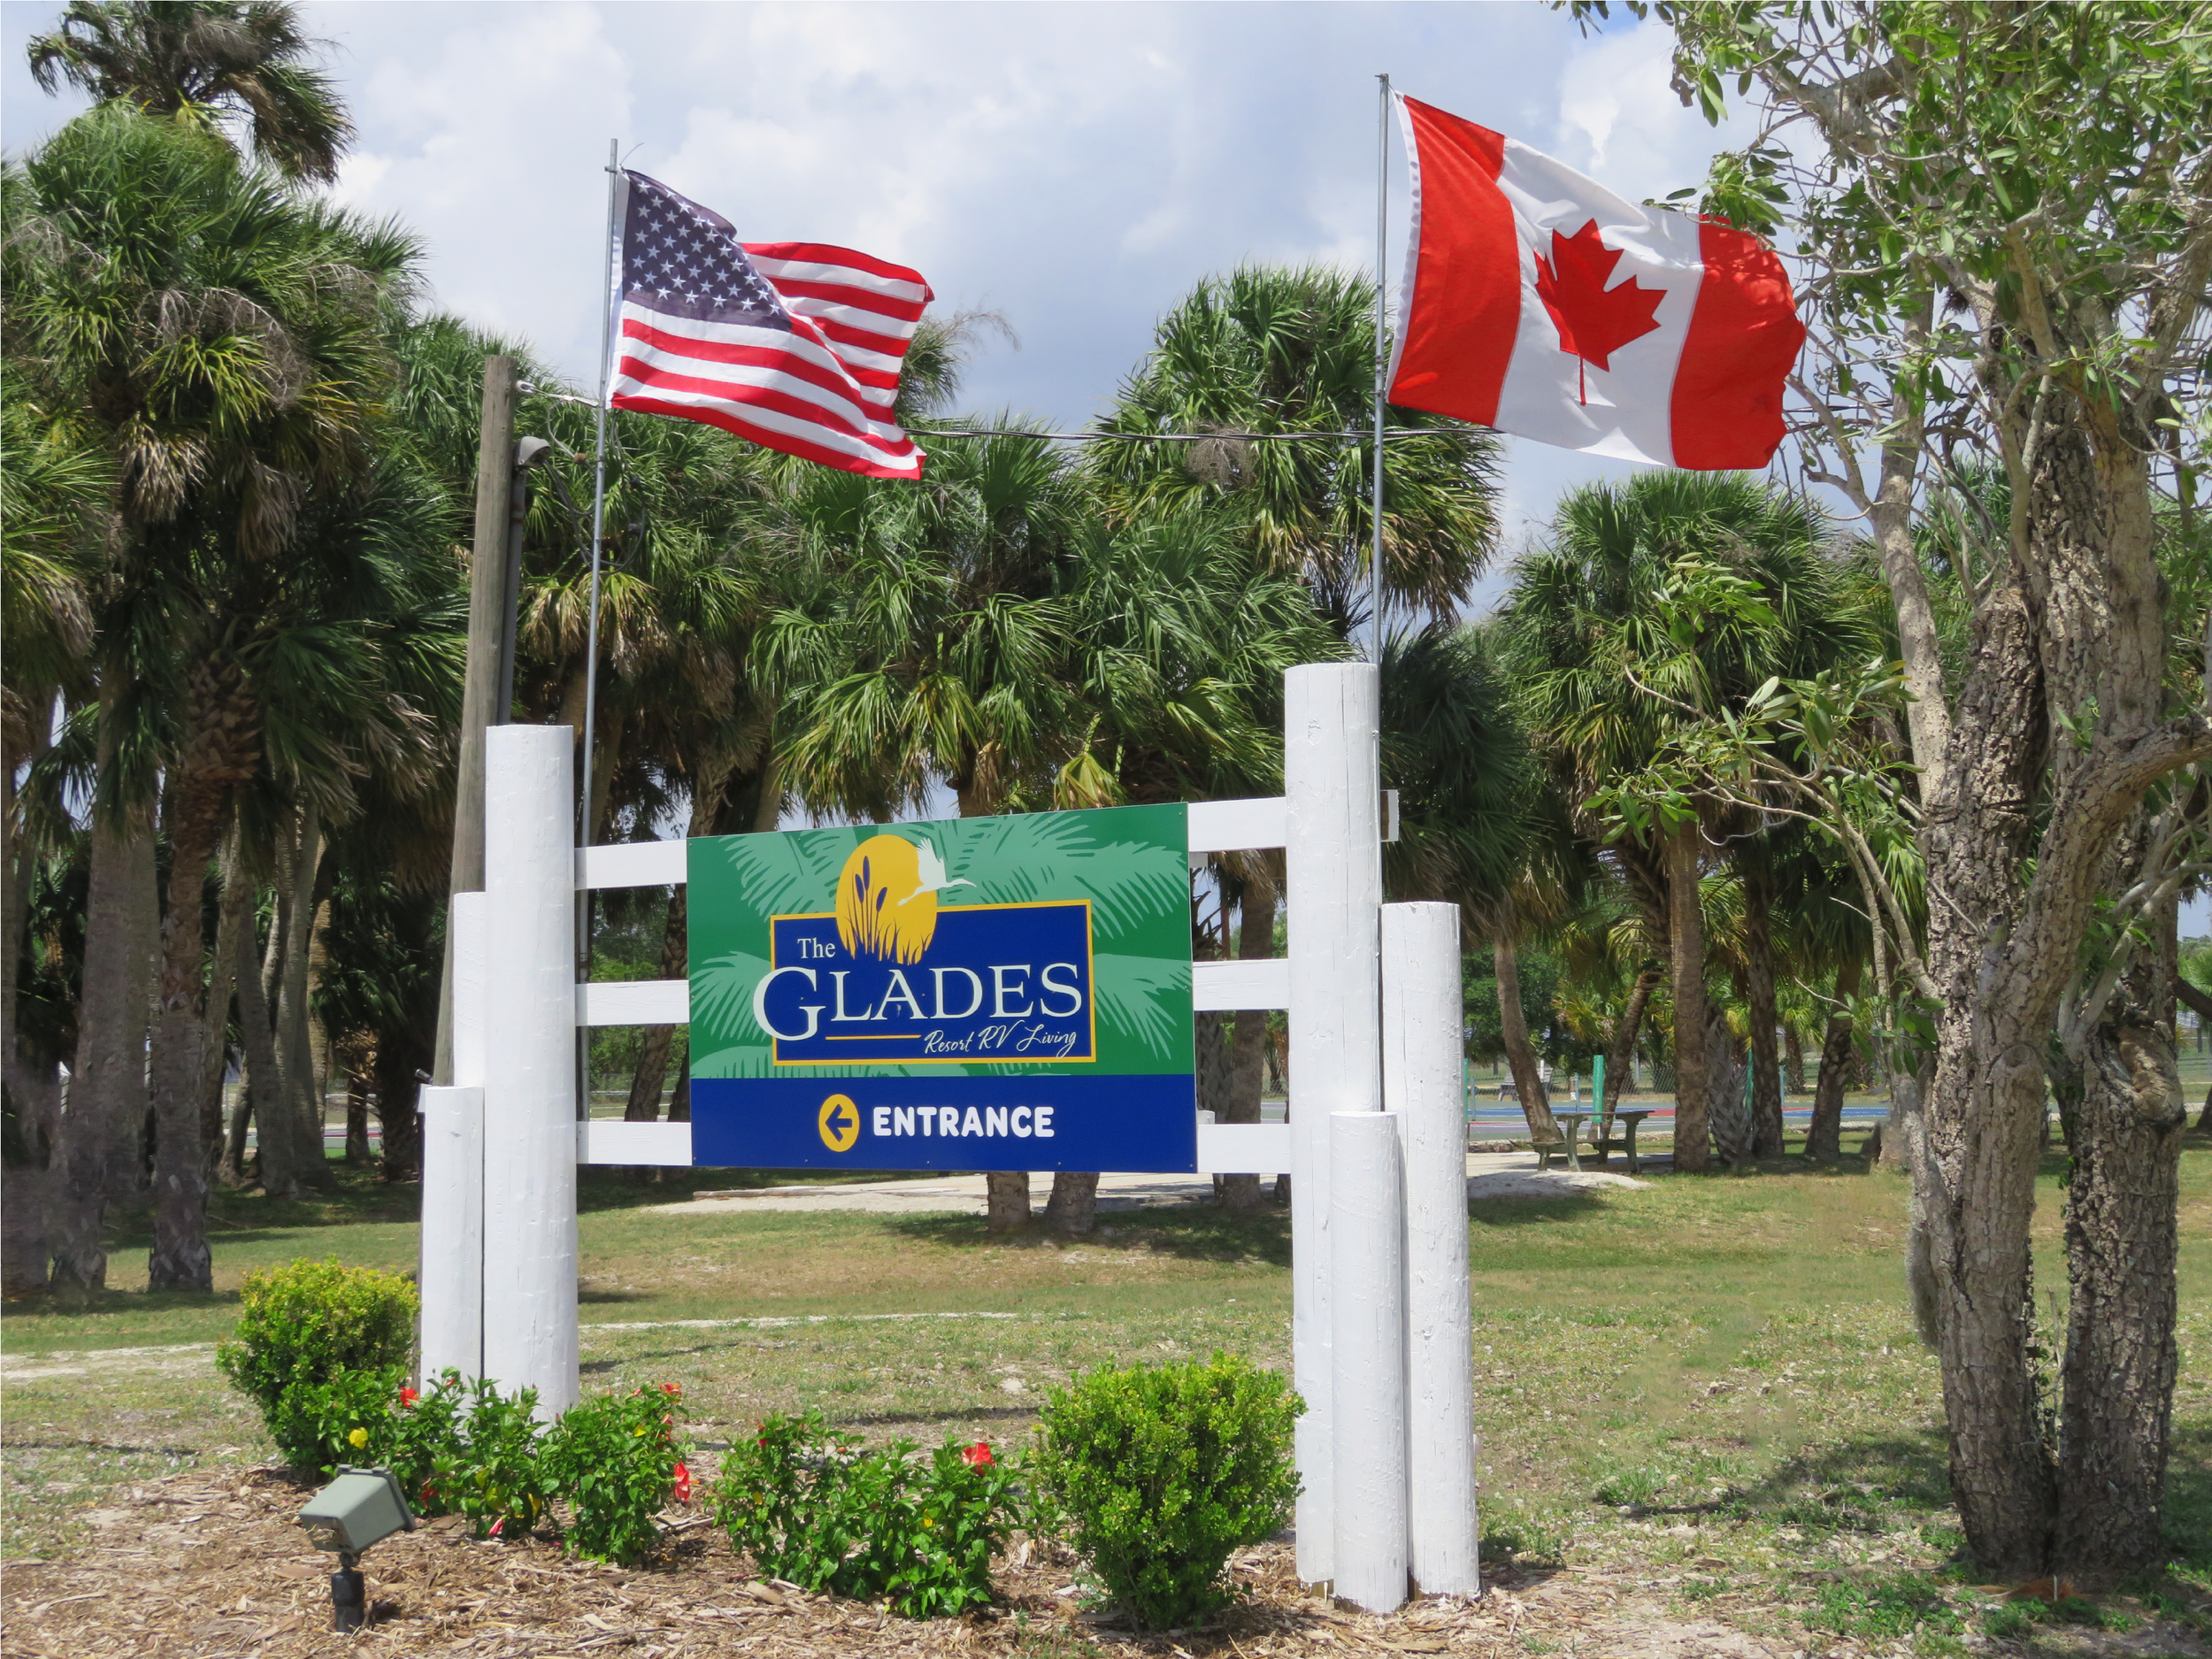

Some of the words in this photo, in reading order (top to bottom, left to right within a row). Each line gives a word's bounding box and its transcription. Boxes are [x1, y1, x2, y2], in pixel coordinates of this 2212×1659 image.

[797, 938, 836, 959] The
[752, 962, 1082, 1041] GLADES
[924, 1029, 975, 1055] Resort
[978, 1019, 1025, 1050] RV
[1016, 1024, 1077, 1059] Living
[872, 1105, 1056, 1139] ENTRANCE
